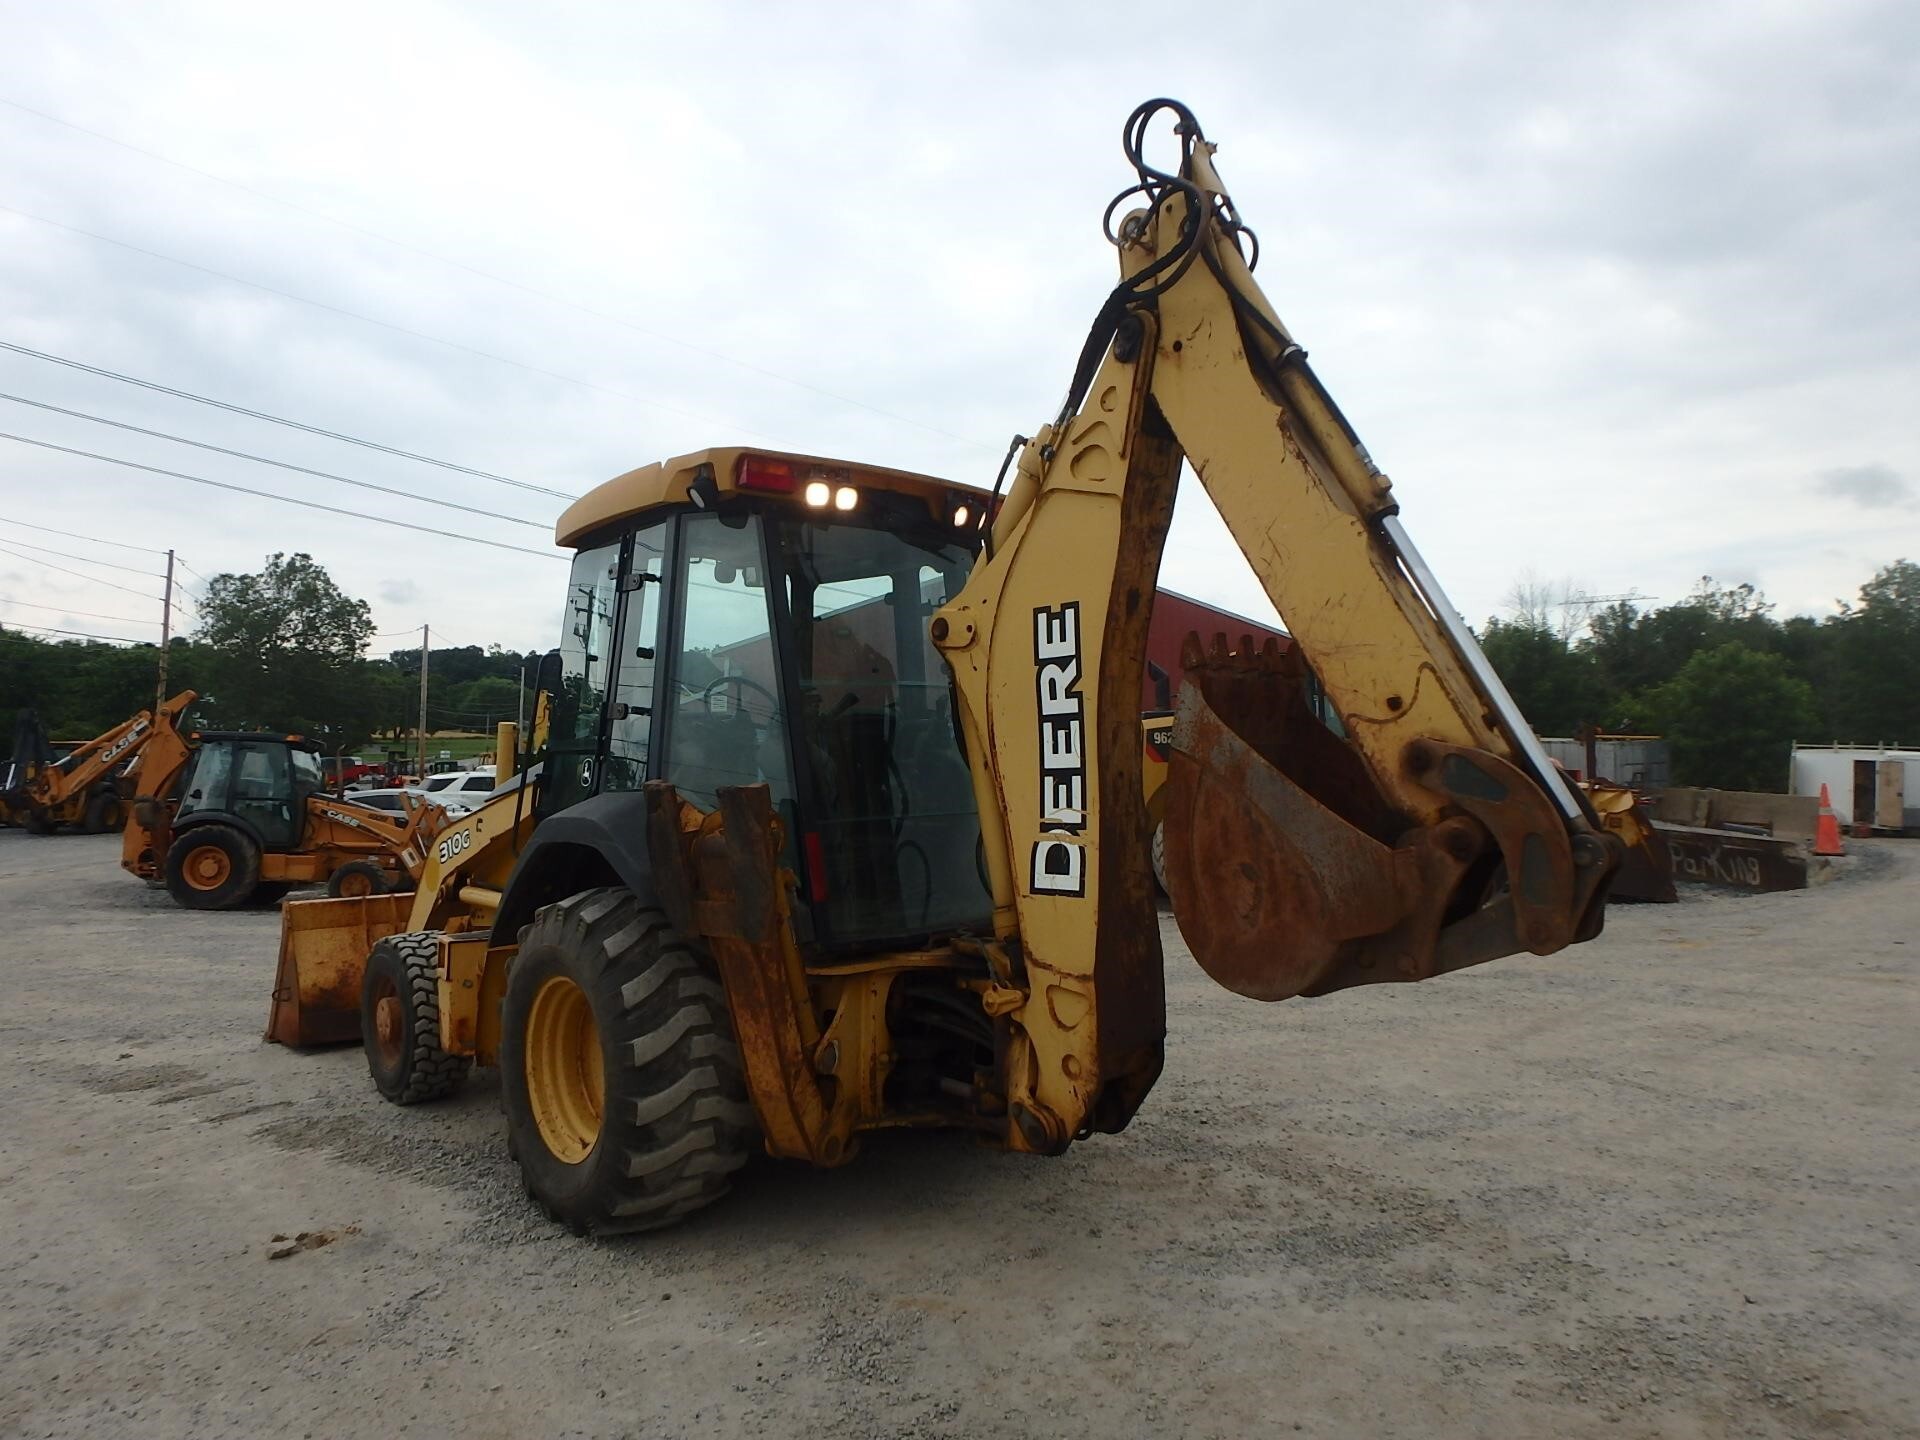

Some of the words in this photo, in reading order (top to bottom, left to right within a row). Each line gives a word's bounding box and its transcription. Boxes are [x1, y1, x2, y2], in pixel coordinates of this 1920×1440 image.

[102, 730, 138, 762] CASE
[1032, 601, 1087, 897] DEERE
[327, 810, 360, 827] CASE
[439, 828, 471, 864] 310G
